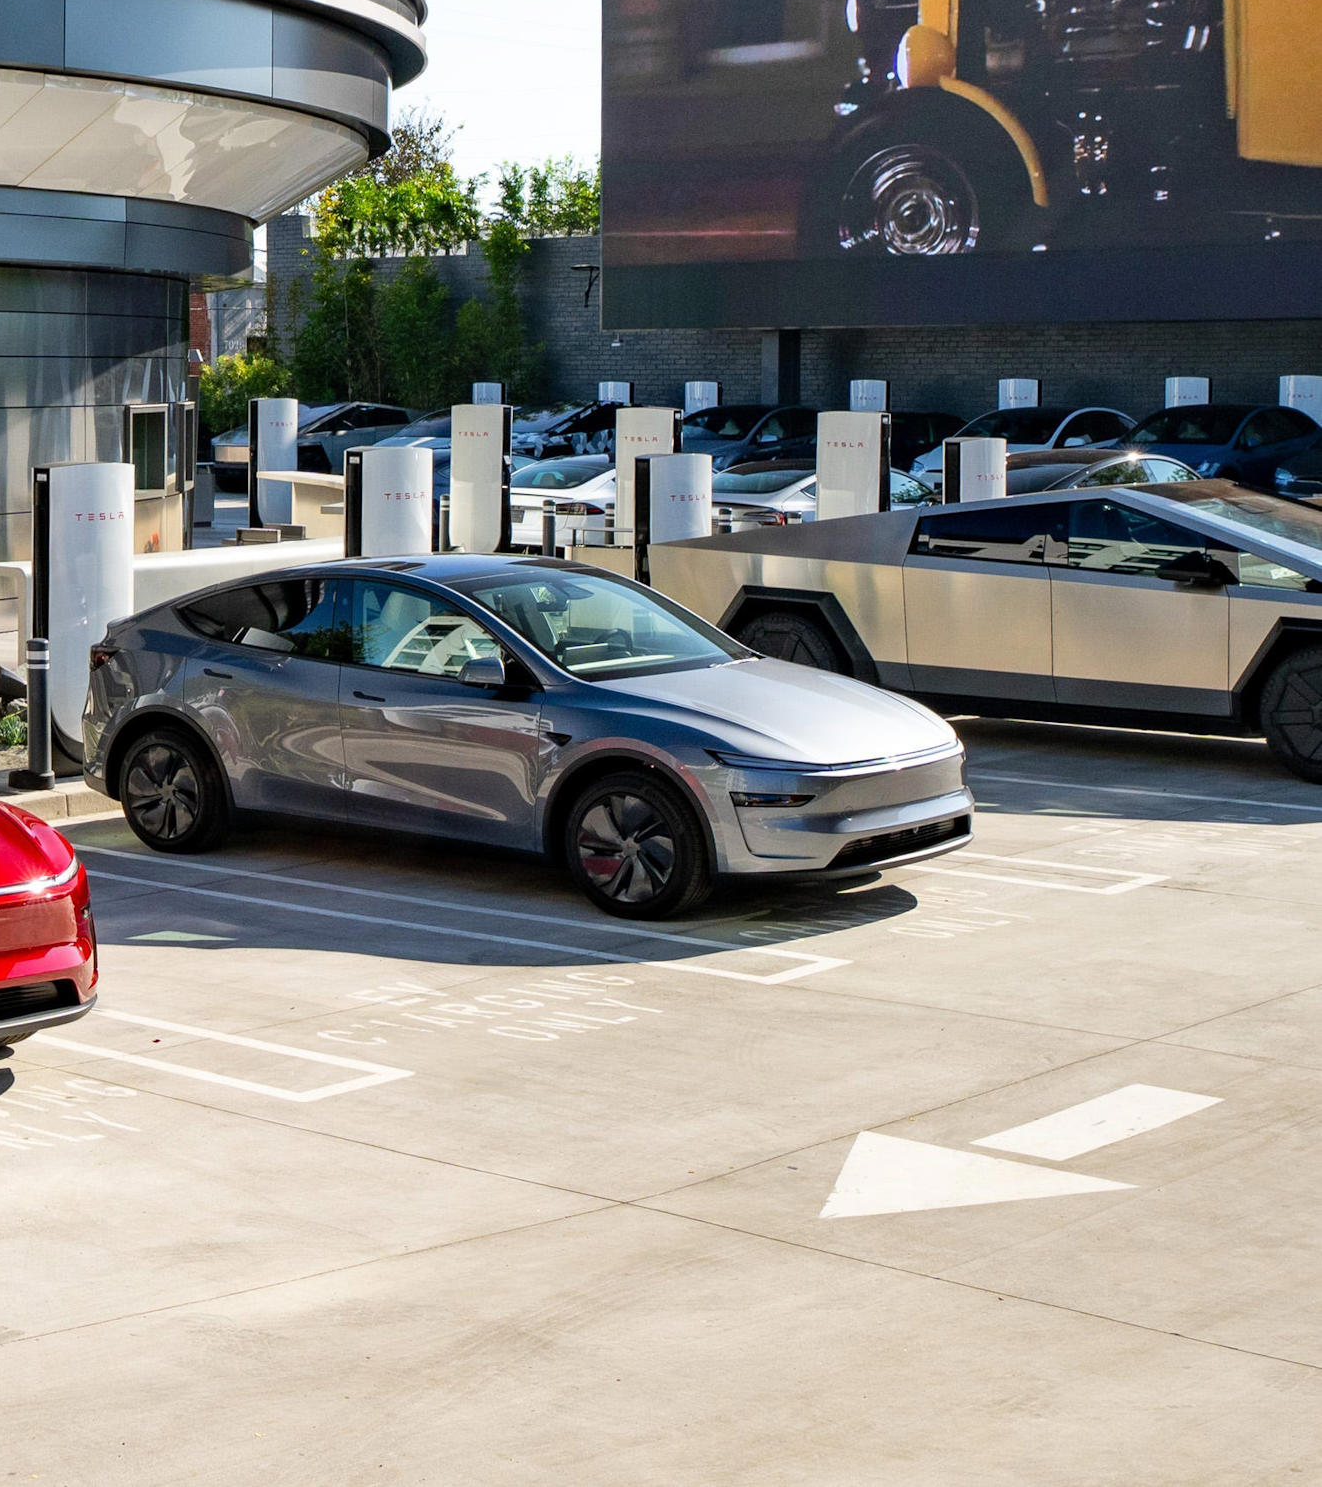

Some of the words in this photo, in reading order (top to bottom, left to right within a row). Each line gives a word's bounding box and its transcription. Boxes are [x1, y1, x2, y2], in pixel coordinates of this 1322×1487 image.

[624, 435, 659, 443] TESLA
[383, 491, 429, 501] TESLA
[74, 511, 126, 522] TESLA
[886, 905, 1033, 940] ONLY
[346, 980, 450, 1008] EV
[487, 997, 665, 1042] ONLY
